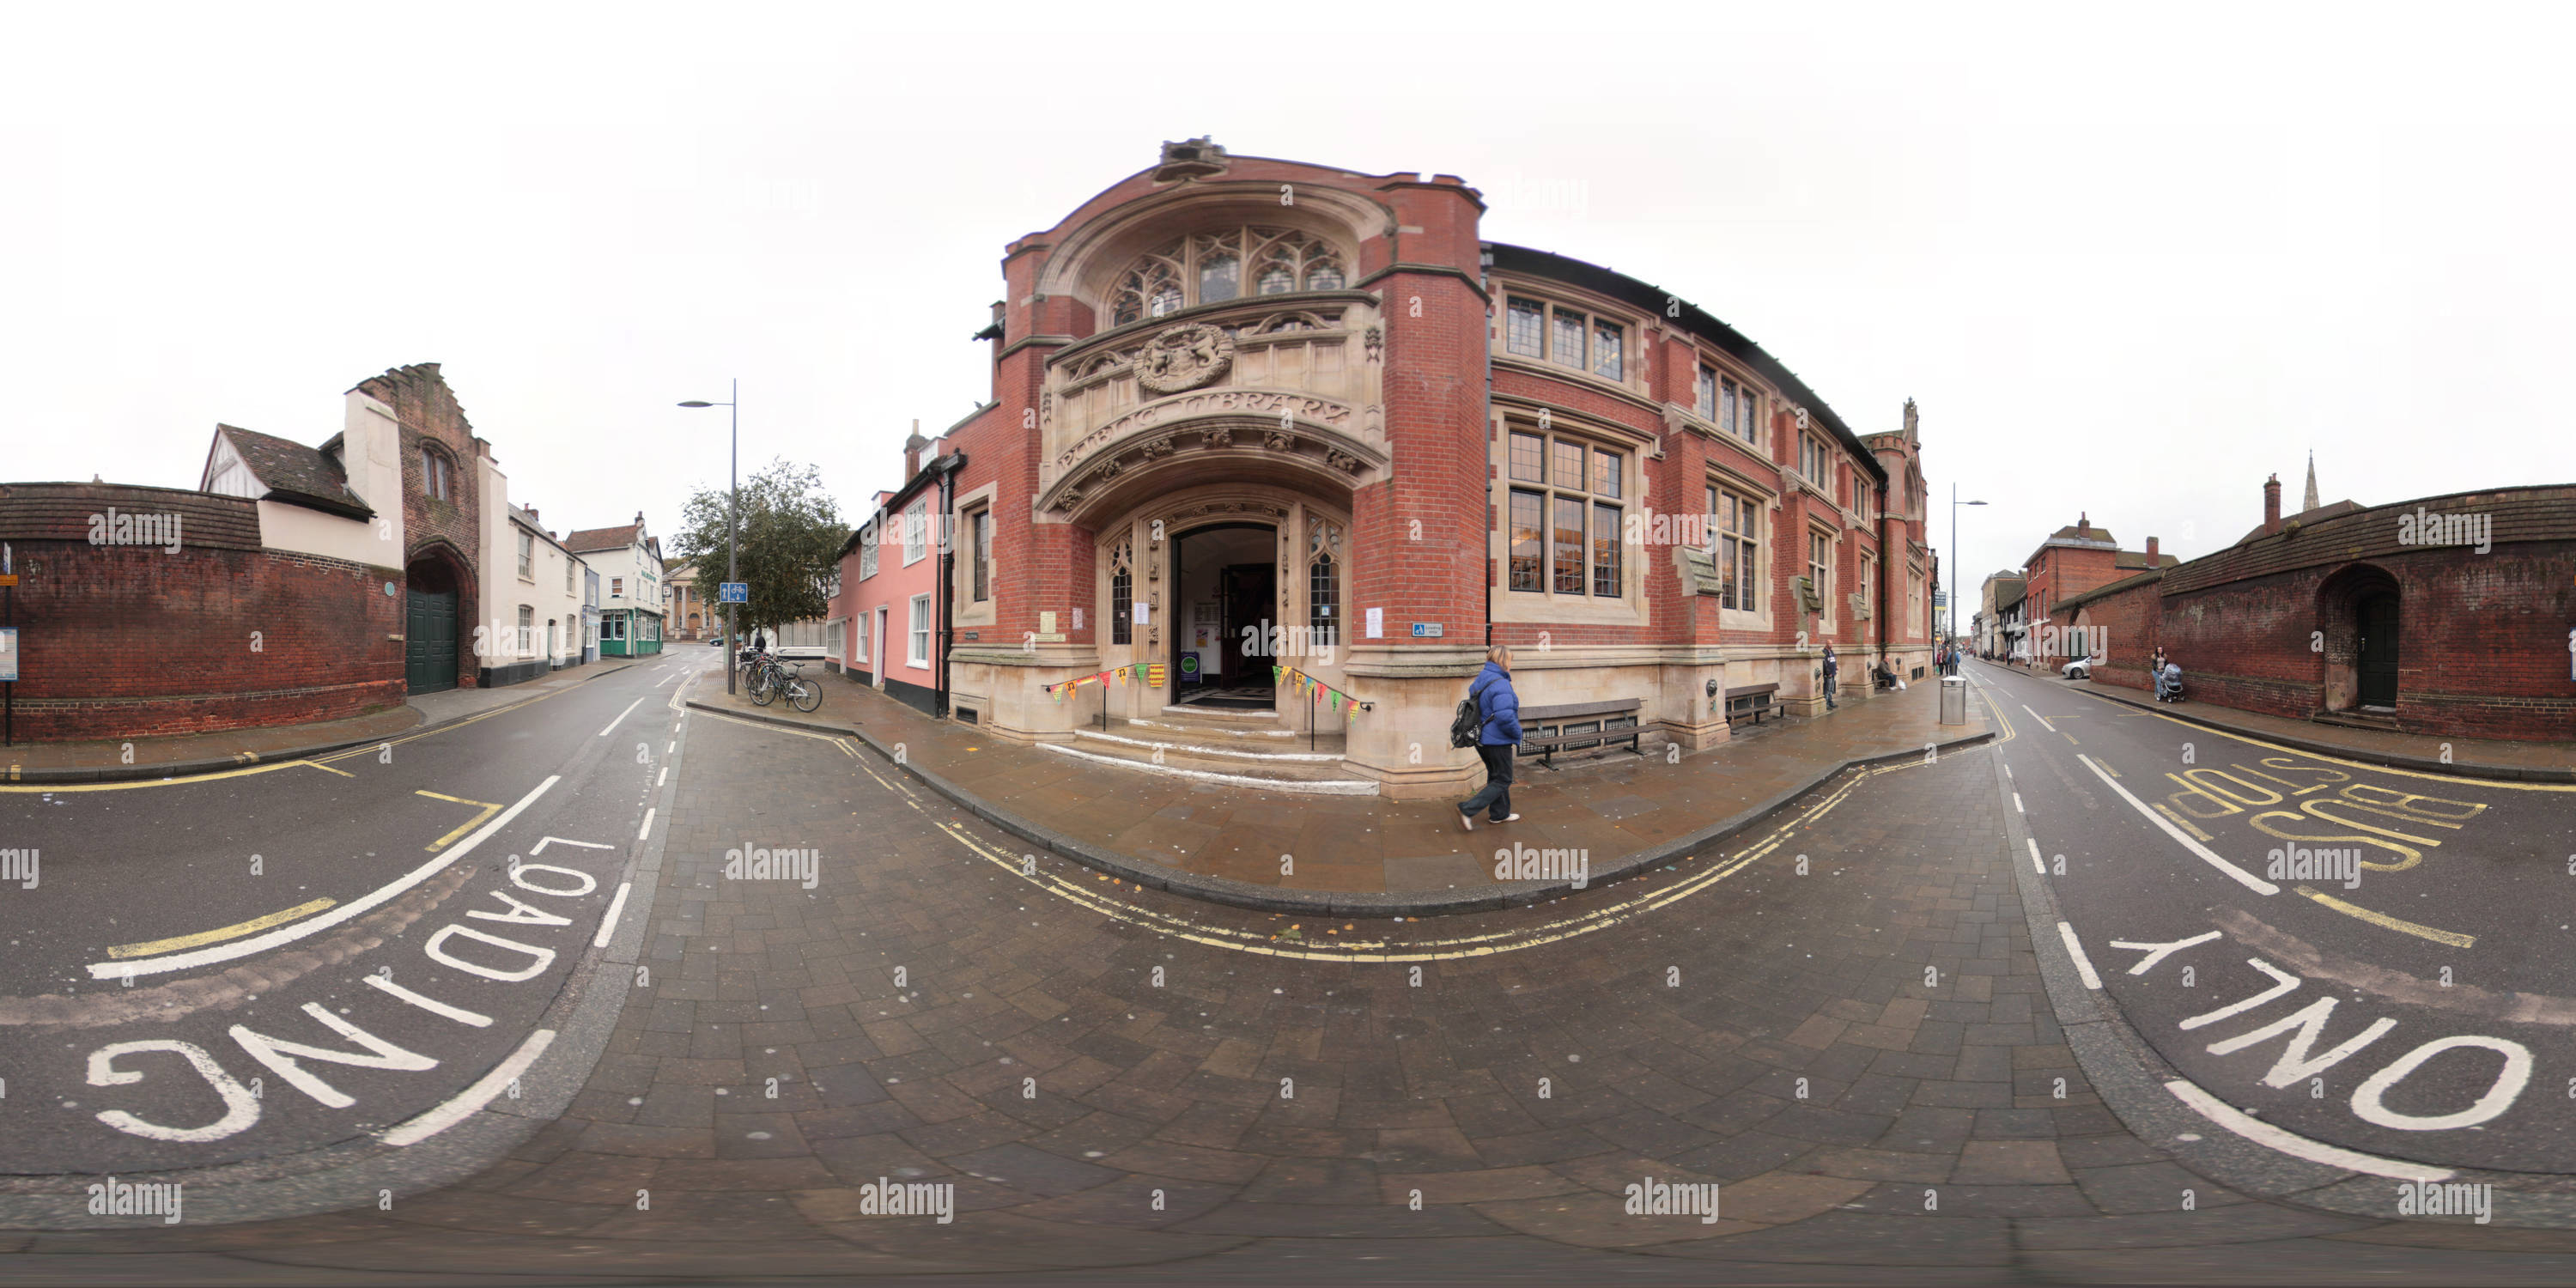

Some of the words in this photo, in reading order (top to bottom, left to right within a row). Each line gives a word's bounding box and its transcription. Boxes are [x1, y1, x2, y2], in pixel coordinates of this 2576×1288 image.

[1058, 406, 1157, 469] PUBLIC
[1179, 392, 1352, 425] LIBRARY
[2165, 757, 2351, 818] STOP
[2249, 783, 2488, 872] BUS
[86, 835, 616, 1143] LOADING
[2109, 930, 2534, 1131] ONLY
